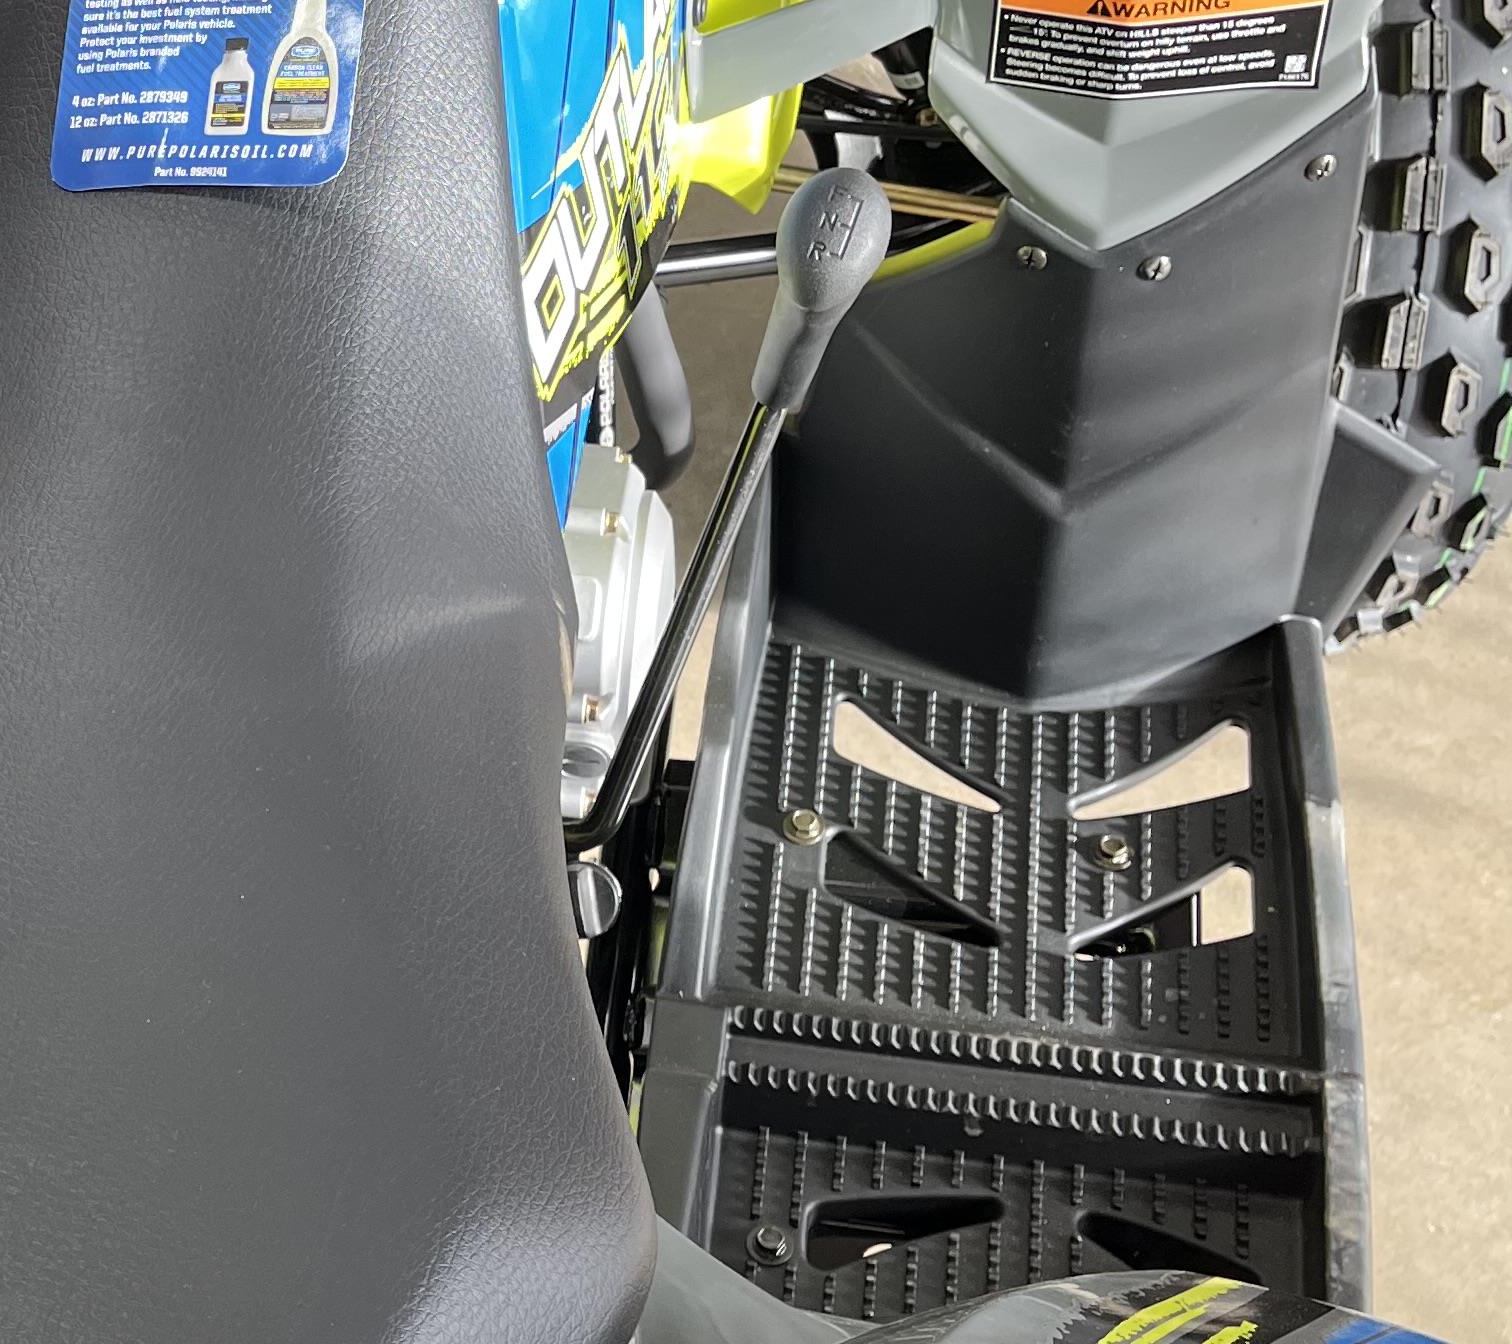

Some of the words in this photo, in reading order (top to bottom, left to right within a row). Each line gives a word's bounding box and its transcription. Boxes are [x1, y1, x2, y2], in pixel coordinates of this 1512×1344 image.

[71, 95, 80, 106] 4
[96, 93, 119, 105] Part
[69, 115, 83, 128] 12
[98, 114, 122, 126] Part
[141, 111, 189, 124] 2871326
[80, 141, 314, 163] WWW.PUREPOLARISOIL.COM
[153, 167, 174, 177] Part
[175, 167, 189, 176] No.
[819, 211, 837, 231] N
[807, 241, 825, 261] R
